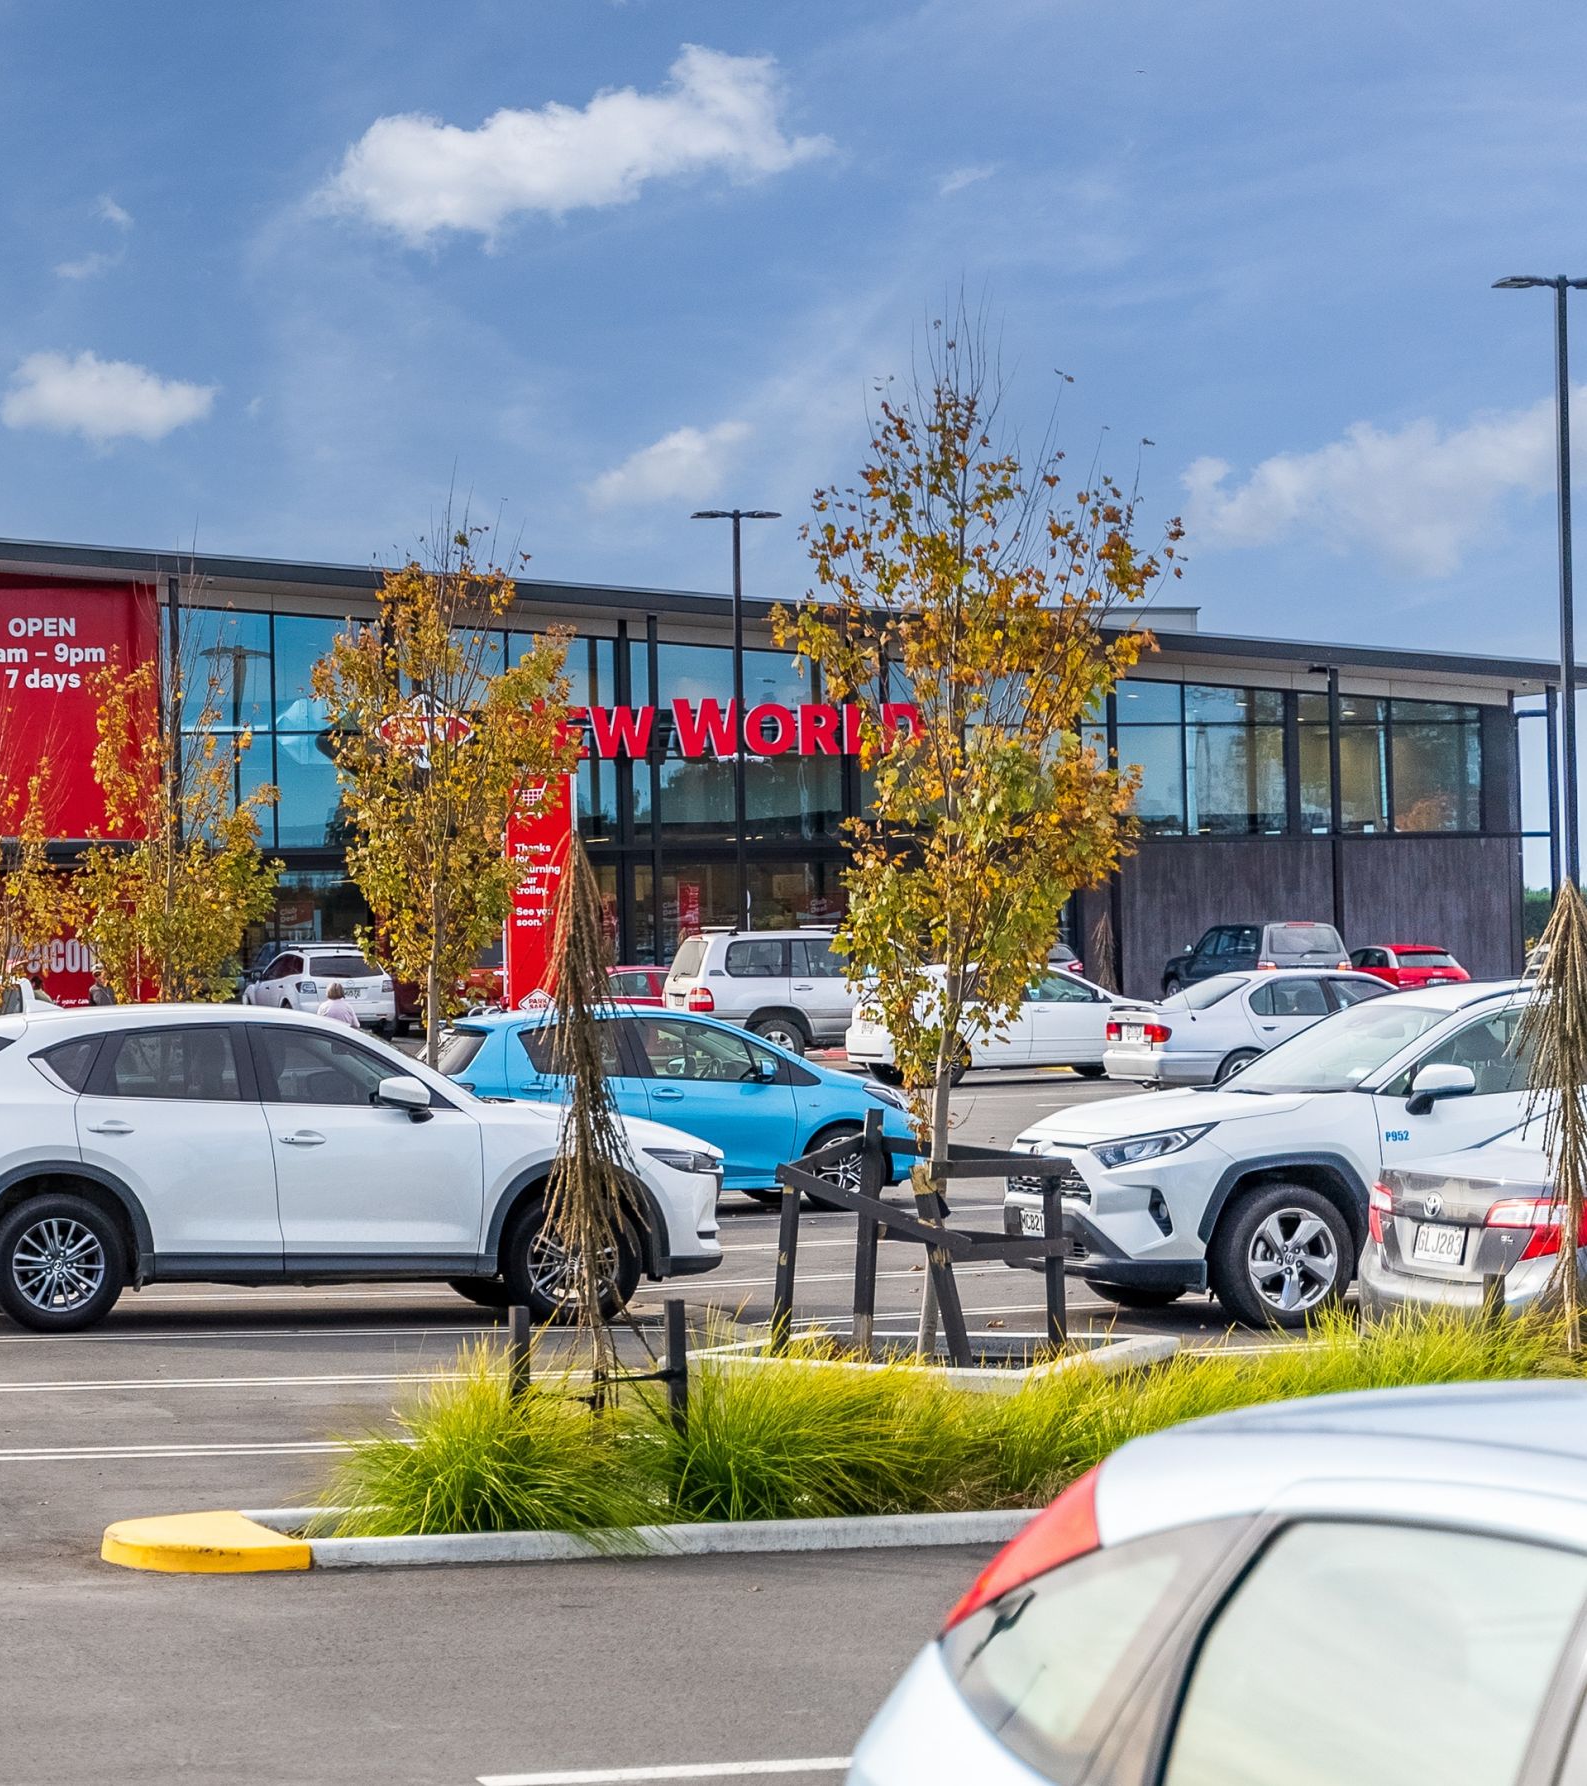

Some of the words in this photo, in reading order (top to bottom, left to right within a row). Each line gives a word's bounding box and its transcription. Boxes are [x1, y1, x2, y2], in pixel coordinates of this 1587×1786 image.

[8, 617, 76, 637] OPEN
[54, 642, 106, 667] 9pm
[5, 669, 19, 688] 7
[25, 667, 81, 692] days
[524, 698, 655, 758] EW
[672, 697, 925, 757] WORLD
[515, 843, 551, 853] Thanks
[515, 854, 530, 864] for
[516, 865, 561, 875] urning
[517, 876, 538, 885] our
[516, 907, 535, 916] See
[516, 919, 542, 927] soon.
[1385, 1130, 1410, 1141] P952
[1417, 1229, 1463, 1257] GLJ283
